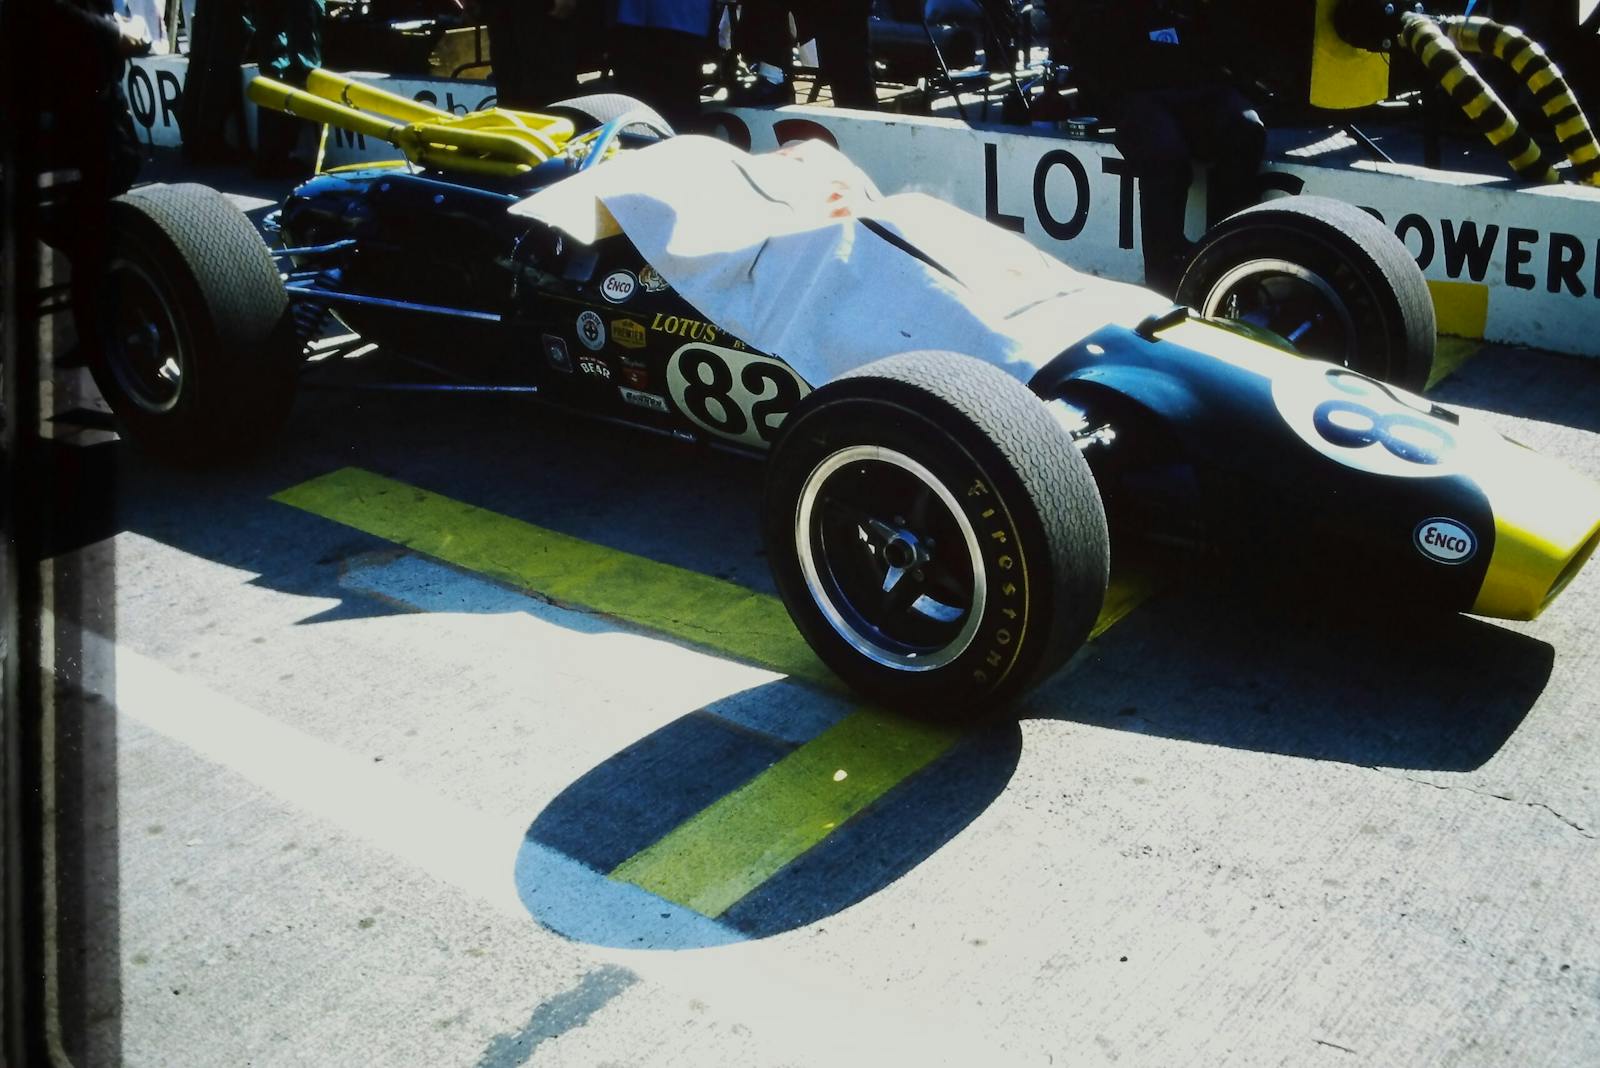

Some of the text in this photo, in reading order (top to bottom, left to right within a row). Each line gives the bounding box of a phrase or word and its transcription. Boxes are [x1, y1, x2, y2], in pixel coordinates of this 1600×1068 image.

[1355, 206, 1600, 299] OWER
[606, 277, 631, 294] ENCO
[651, 312, 719, 344] LOTUS
[580, 362, 610, 380] BEAR
[678, 348, 801, 442] 82
[1424, 526, 1467, 554] ENCO
